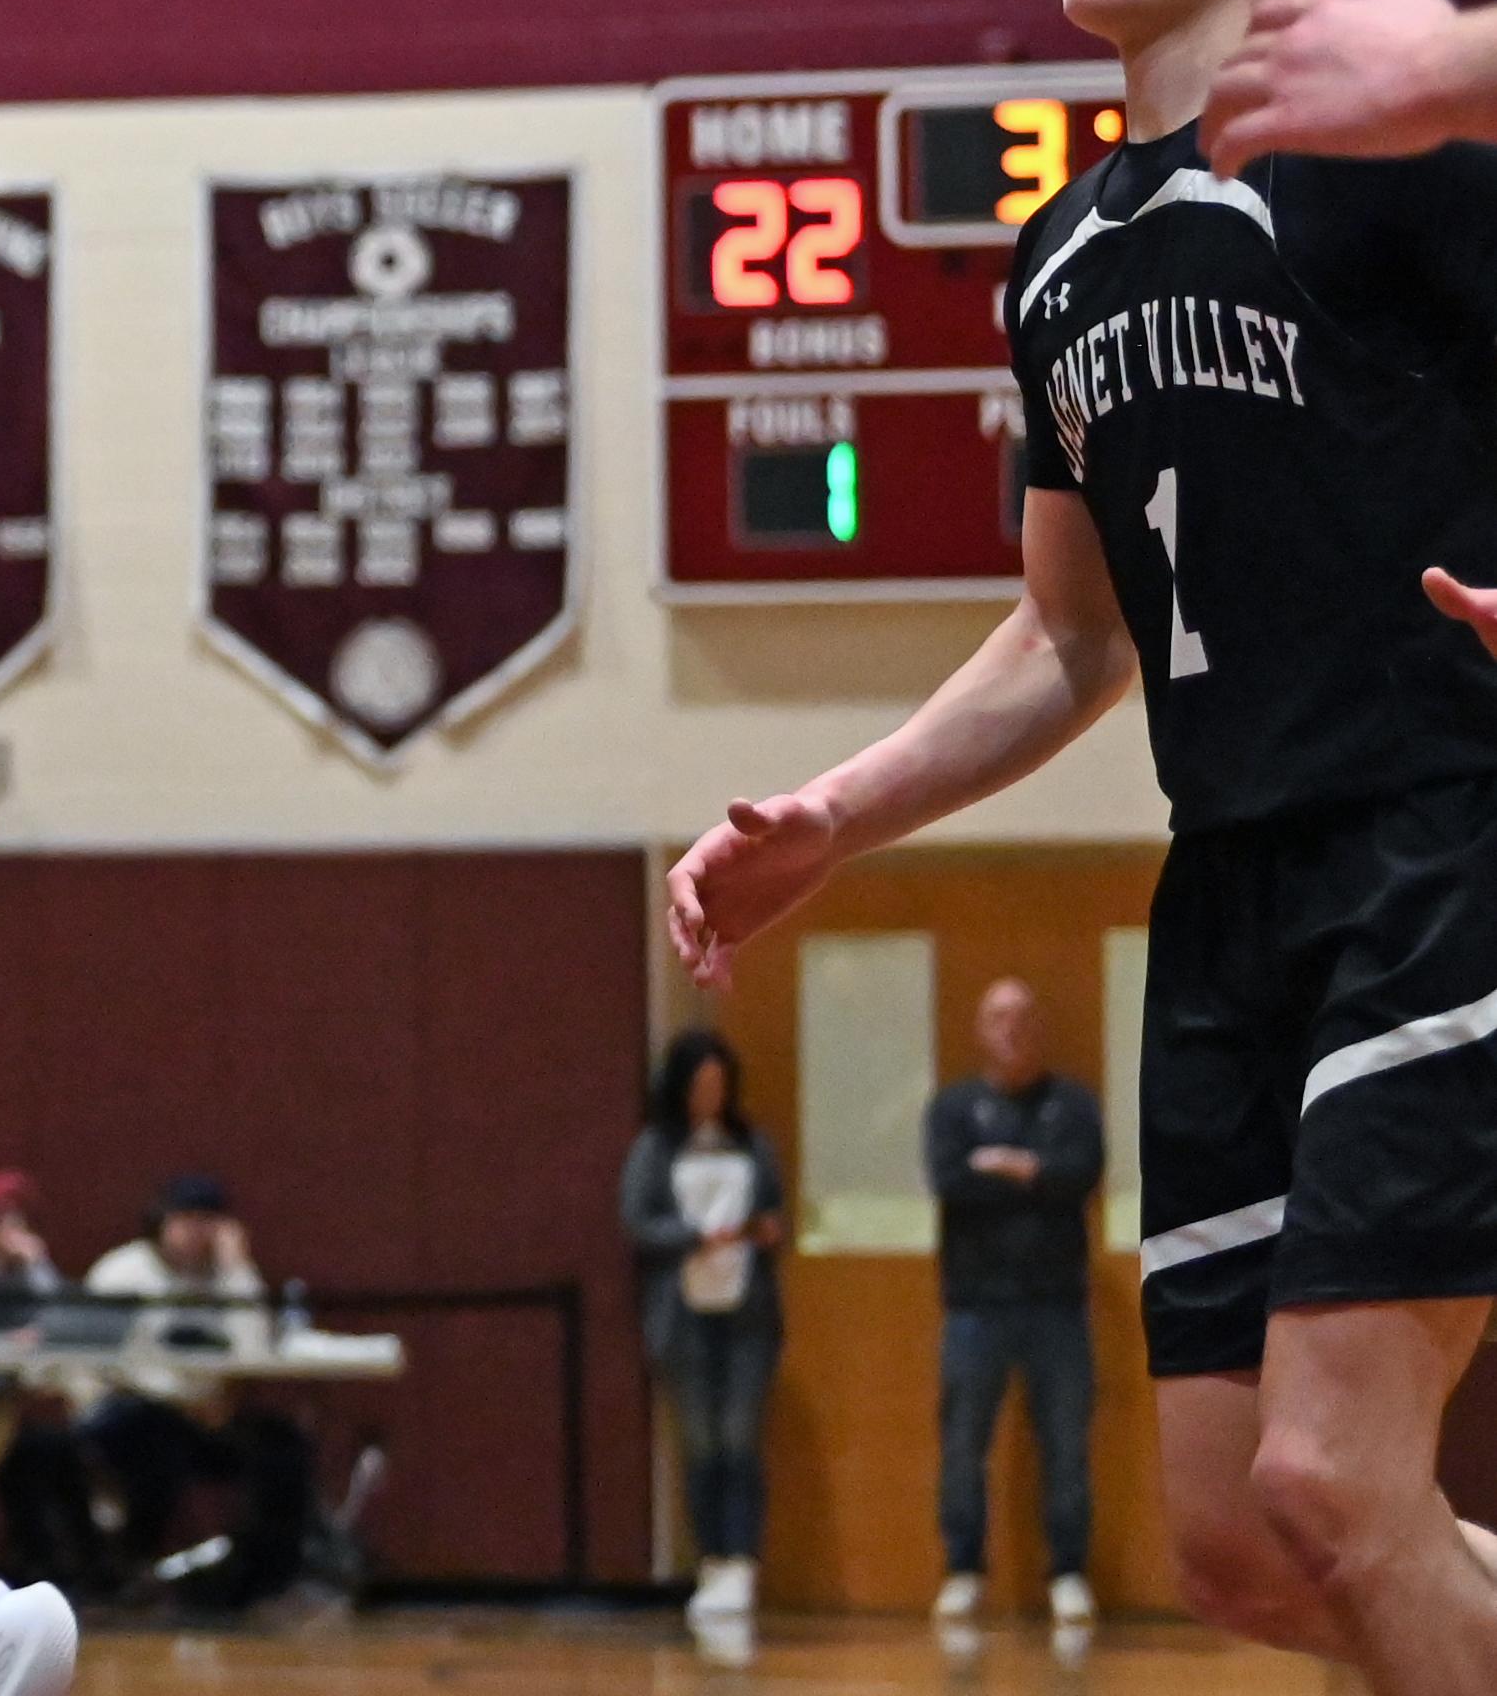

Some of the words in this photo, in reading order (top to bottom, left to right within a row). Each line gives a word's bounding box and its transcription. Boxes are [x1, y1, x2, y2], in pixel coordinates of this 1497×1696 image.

[690, 103, 851, 168] HOME
[711, 177, 863, 307] 22
[748, 313, 887, 368] BONUS
[727, 395, 856, 443] FOULS
[826, 439, 858, 543] 1
[1143, 465, 1210, 680] 1
